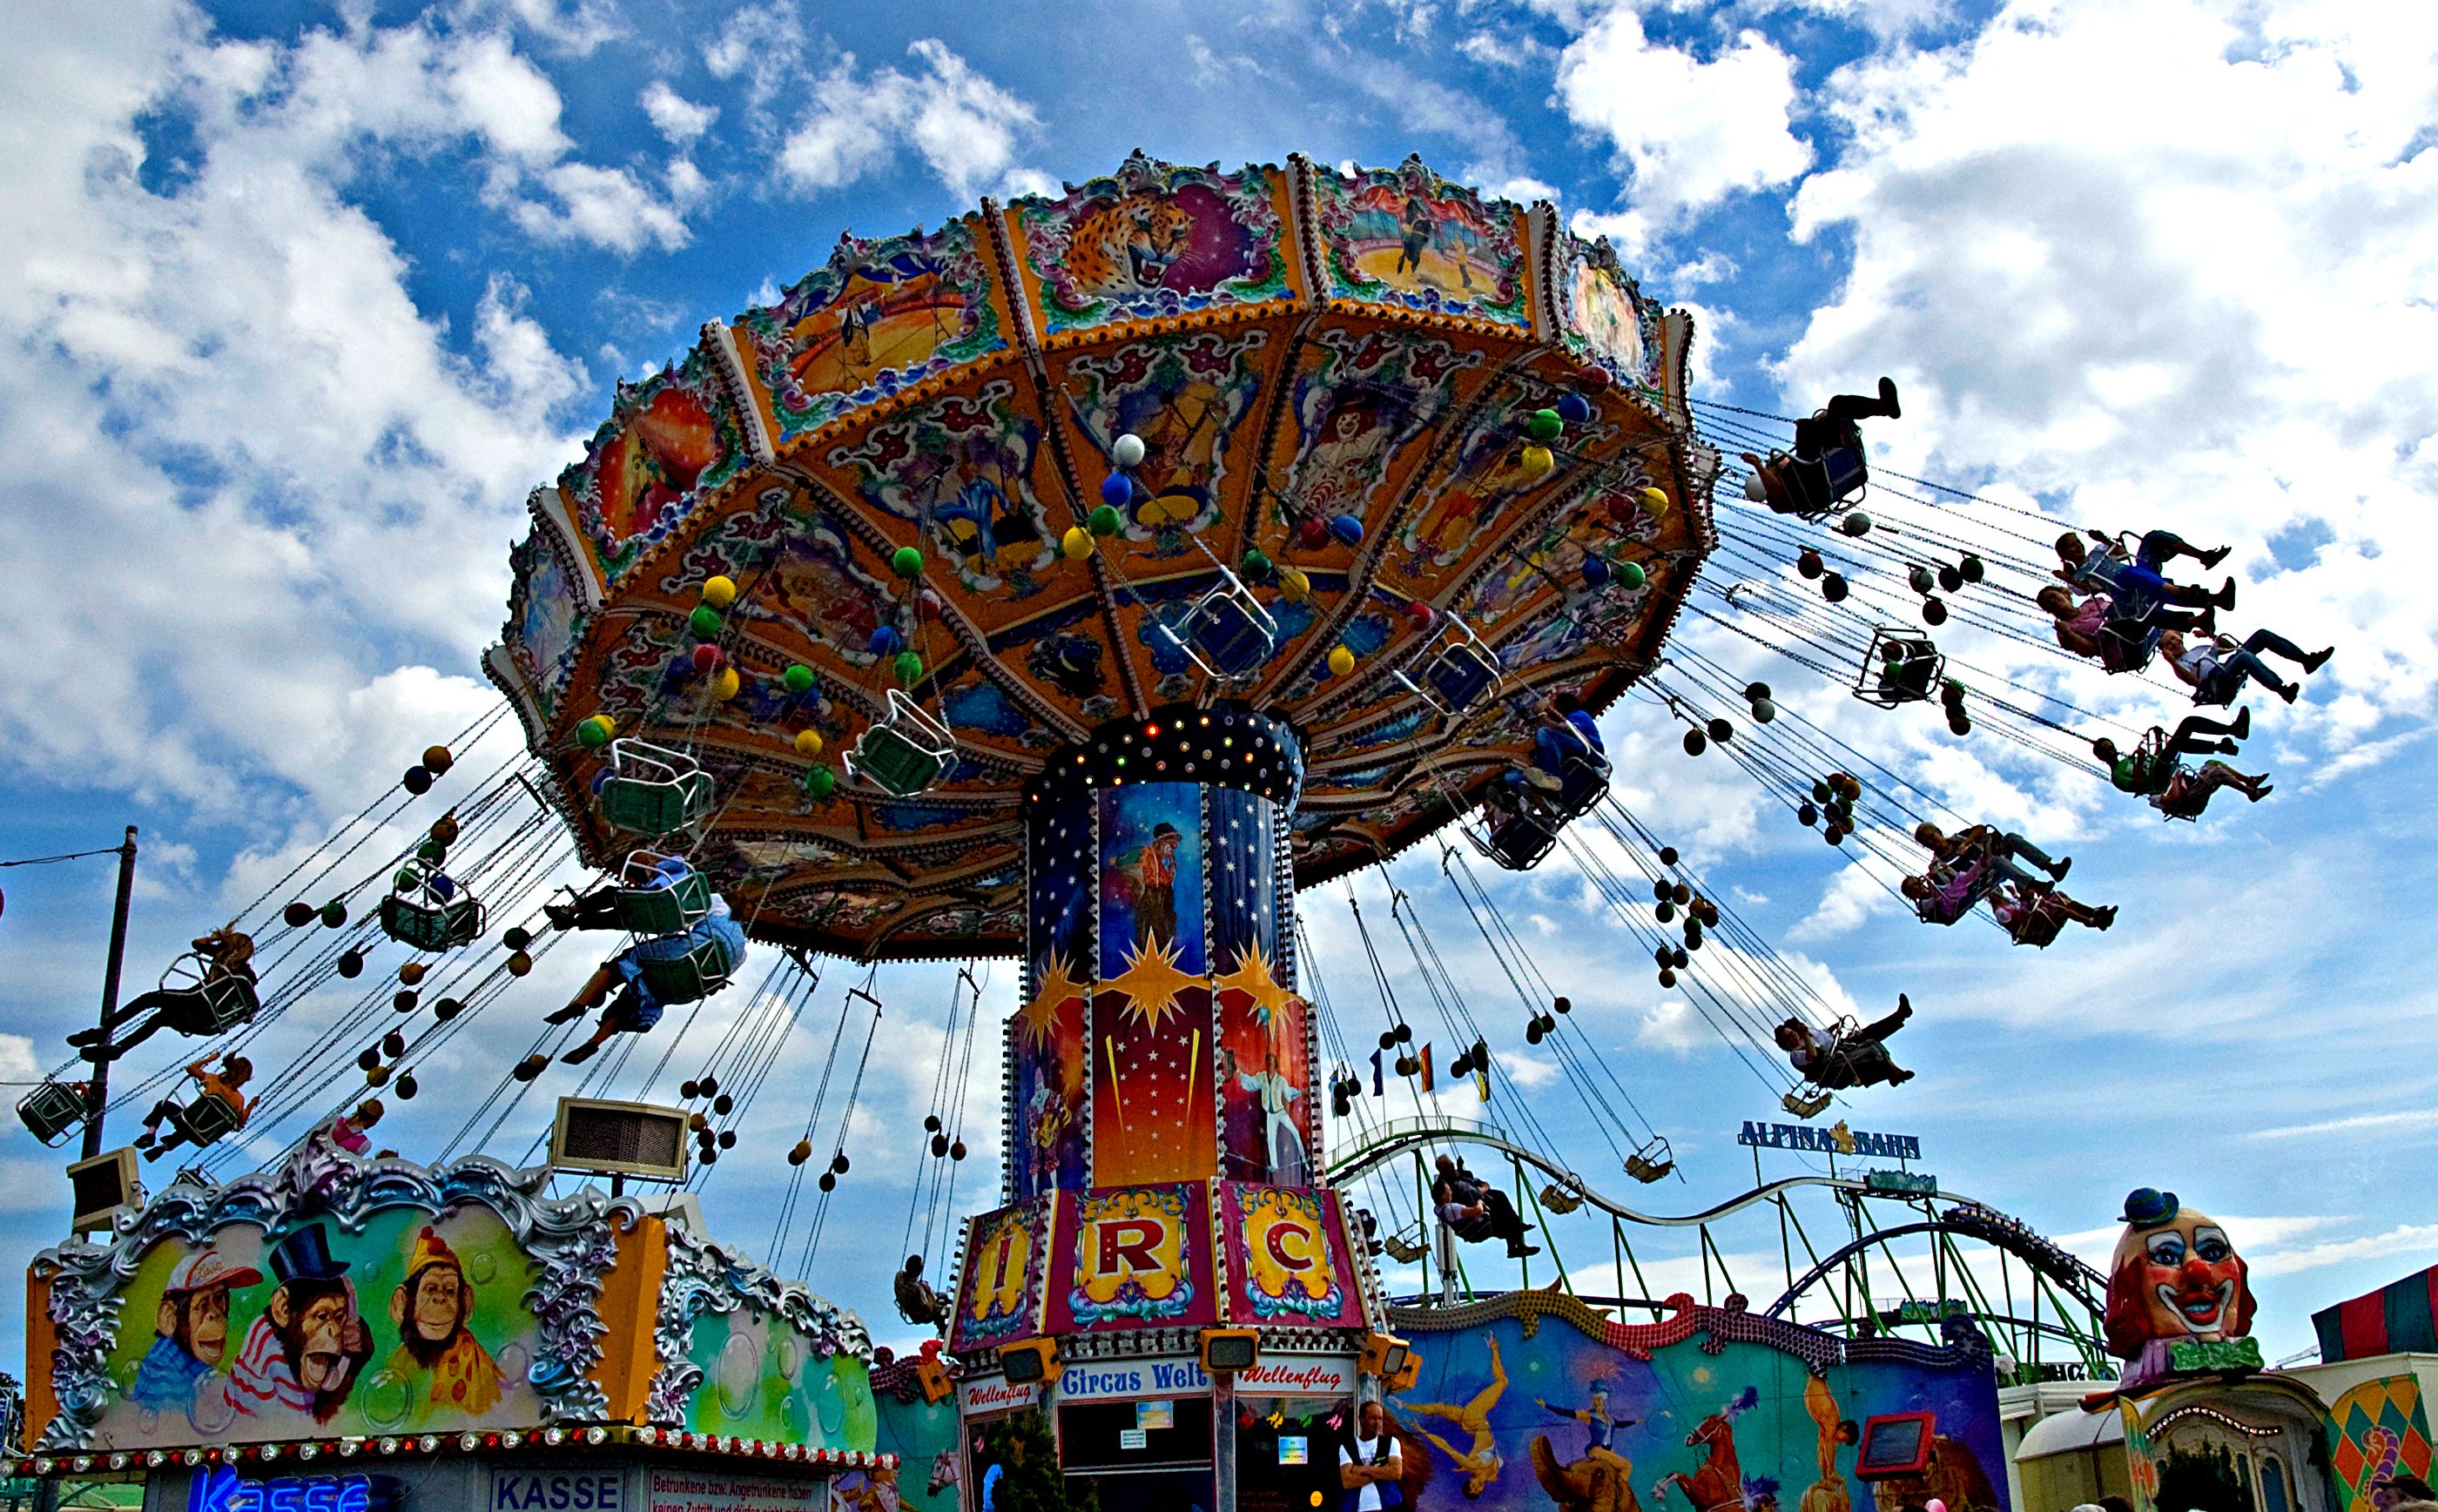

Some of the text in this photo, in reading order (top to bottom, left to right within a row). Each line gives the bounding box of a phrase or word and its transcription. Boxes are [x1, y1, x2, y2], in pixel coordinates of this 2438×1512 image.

[1741, 1120, 1922, 1159] ALPINA BAHN
[968, 1383, 1032, 1406] Wellenflug
[1061, 1361, 1208, 1395] Circus Welt
[1243, 1365, 1342, 1391] Wellenflug
[188, 1462, 369, 1512] Kasse
[497, 1476, 618, 1510] KASSE
[653, 1475, 812, 1501] Betrunkene bzw. Angetrunkene haben
